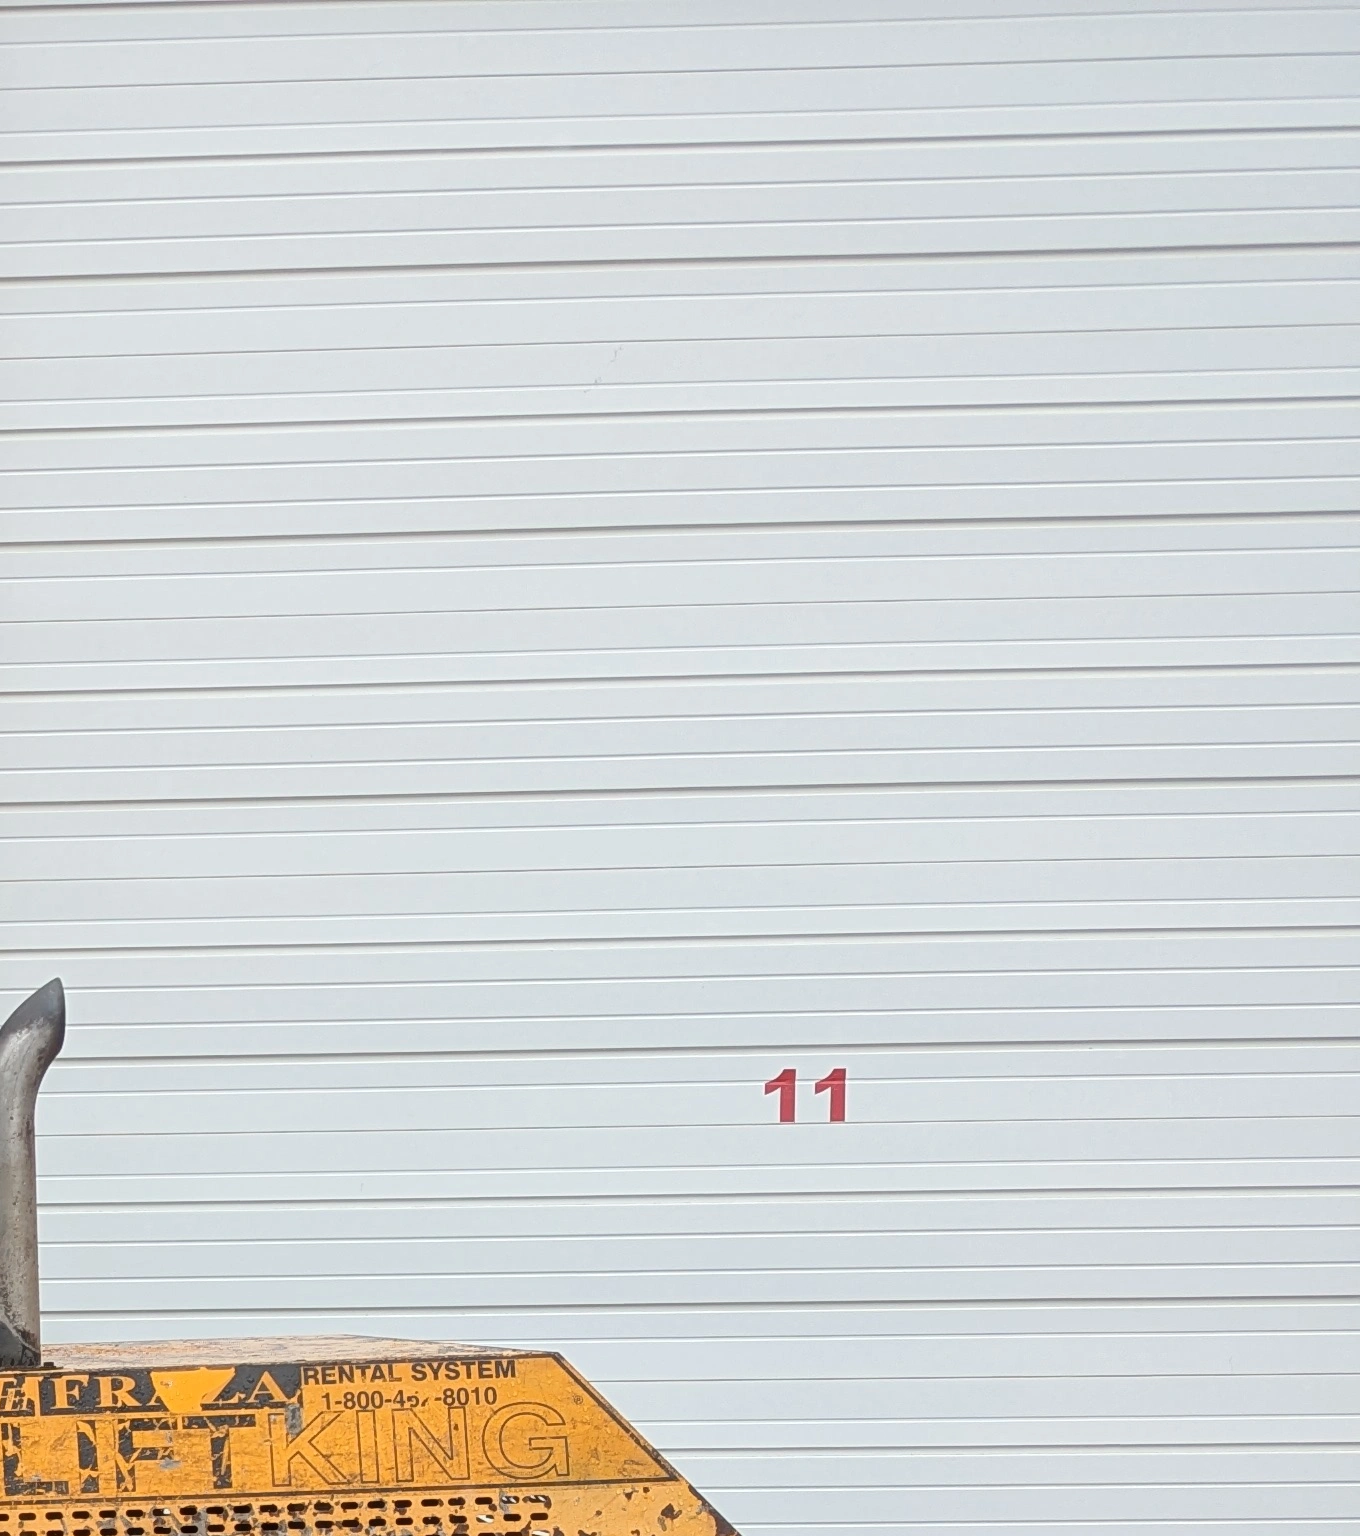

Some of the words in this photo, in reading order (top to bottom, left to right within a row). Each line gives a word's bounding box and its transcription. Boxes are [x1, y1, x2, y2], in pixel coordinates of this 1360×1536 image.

[764, 1067, 847, 1124] 11
[303, 1365, 402, 1385] RENTAL
[411, 1359, 516, 1382] SYSTEM
